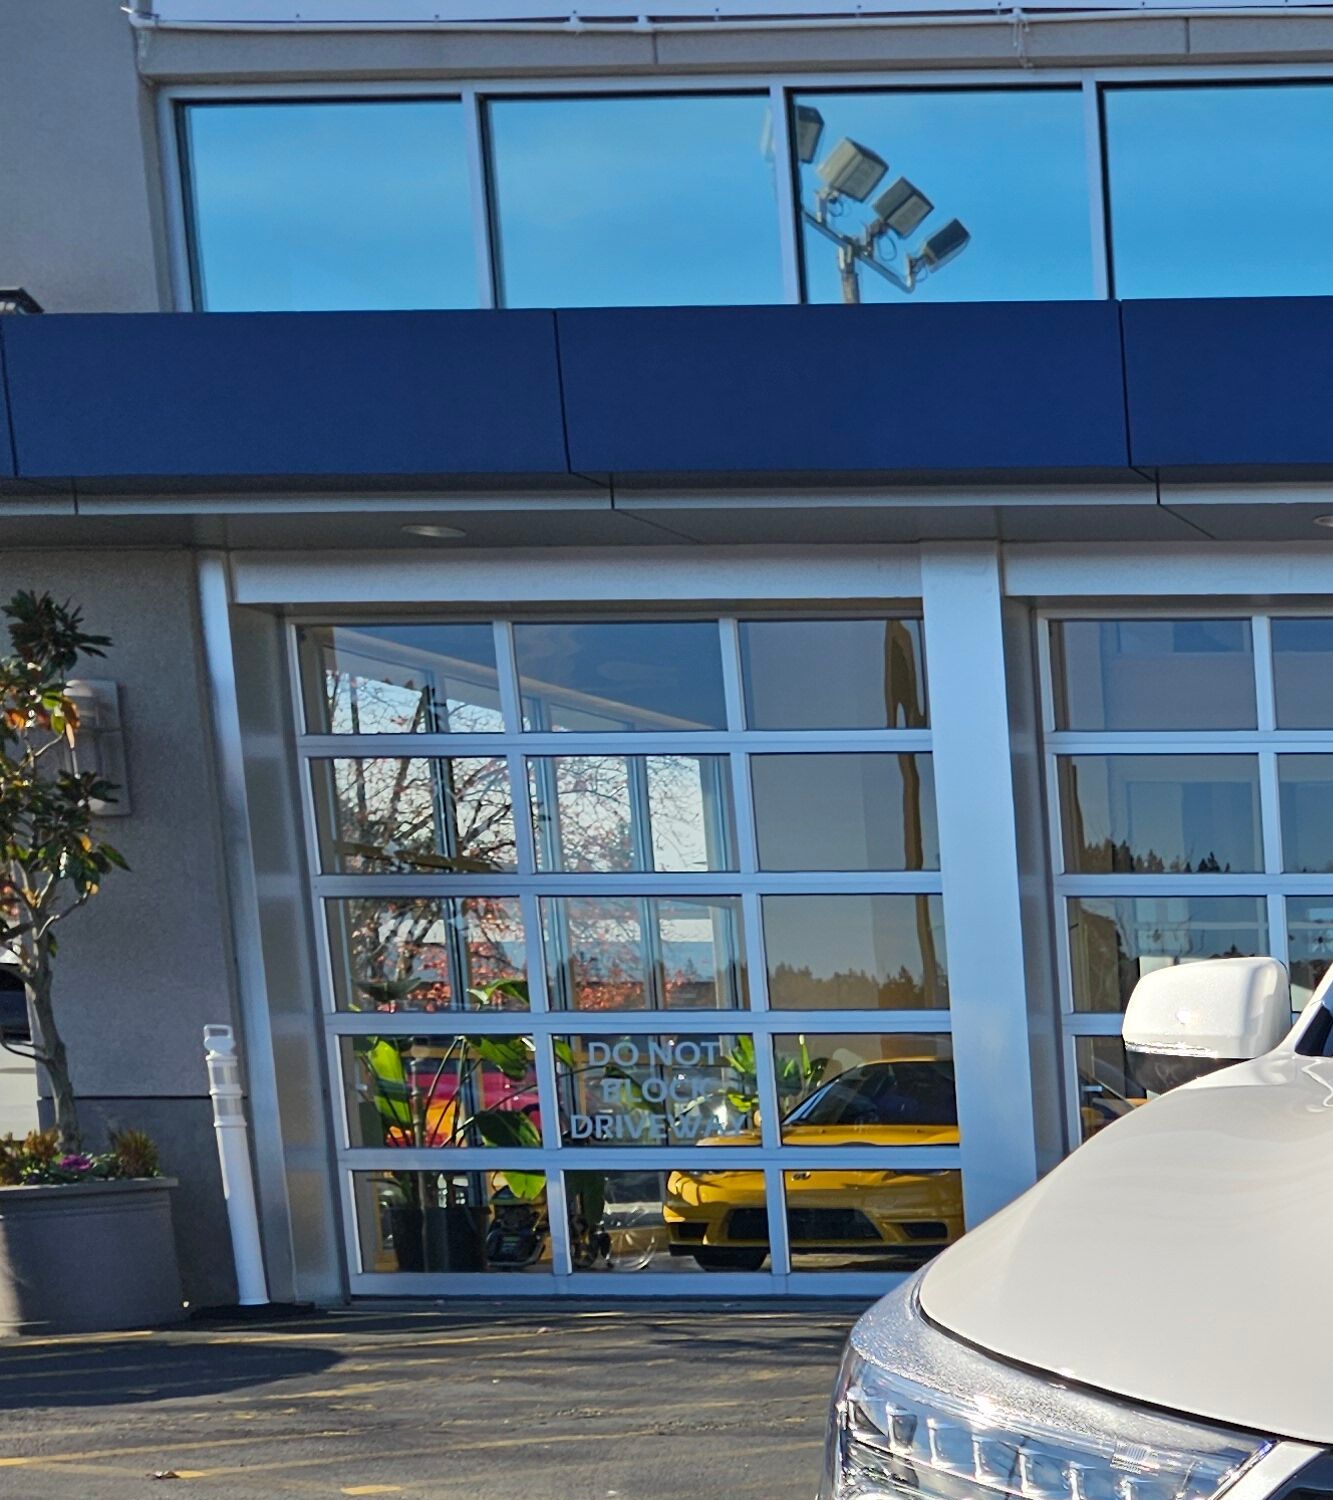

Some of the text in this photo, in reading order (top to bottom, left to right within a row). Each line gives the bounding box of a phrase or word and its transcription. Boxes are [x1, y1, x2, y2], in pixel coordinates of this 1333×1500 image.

[588, 1041, 720, 1066] DO NOT
[602, 1077, 713, 1103] BLOCK
[570, 1114, 746, 1140] DRIVEWAY
